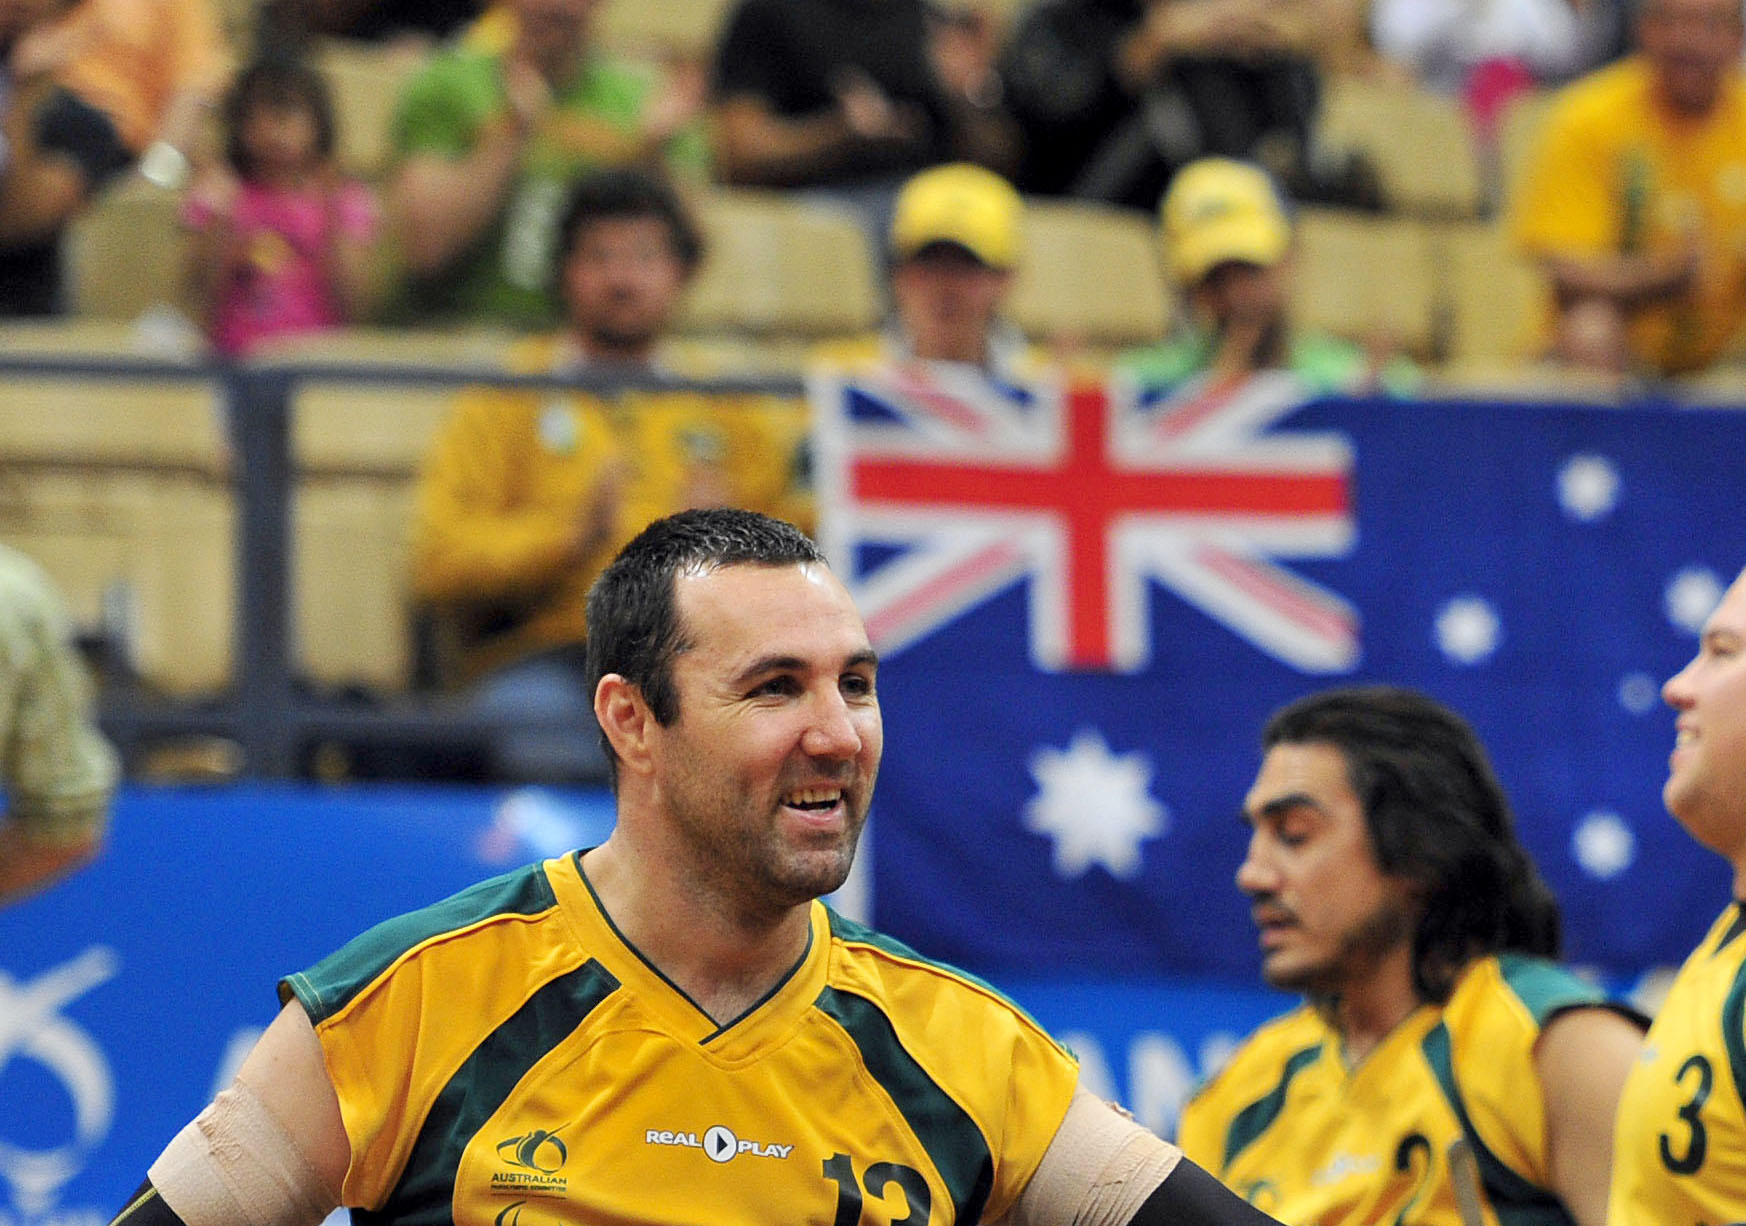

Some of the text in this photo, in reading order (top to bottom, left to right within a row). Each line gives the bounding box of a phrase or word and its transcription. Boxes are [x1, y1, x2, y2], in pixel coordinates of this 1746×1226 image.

[1659, 1055, 1712, 1174] 3
[737, 1139, 793, 1159] PLAY
[491, 1172, 567, 1185] AUSTRALIAN
